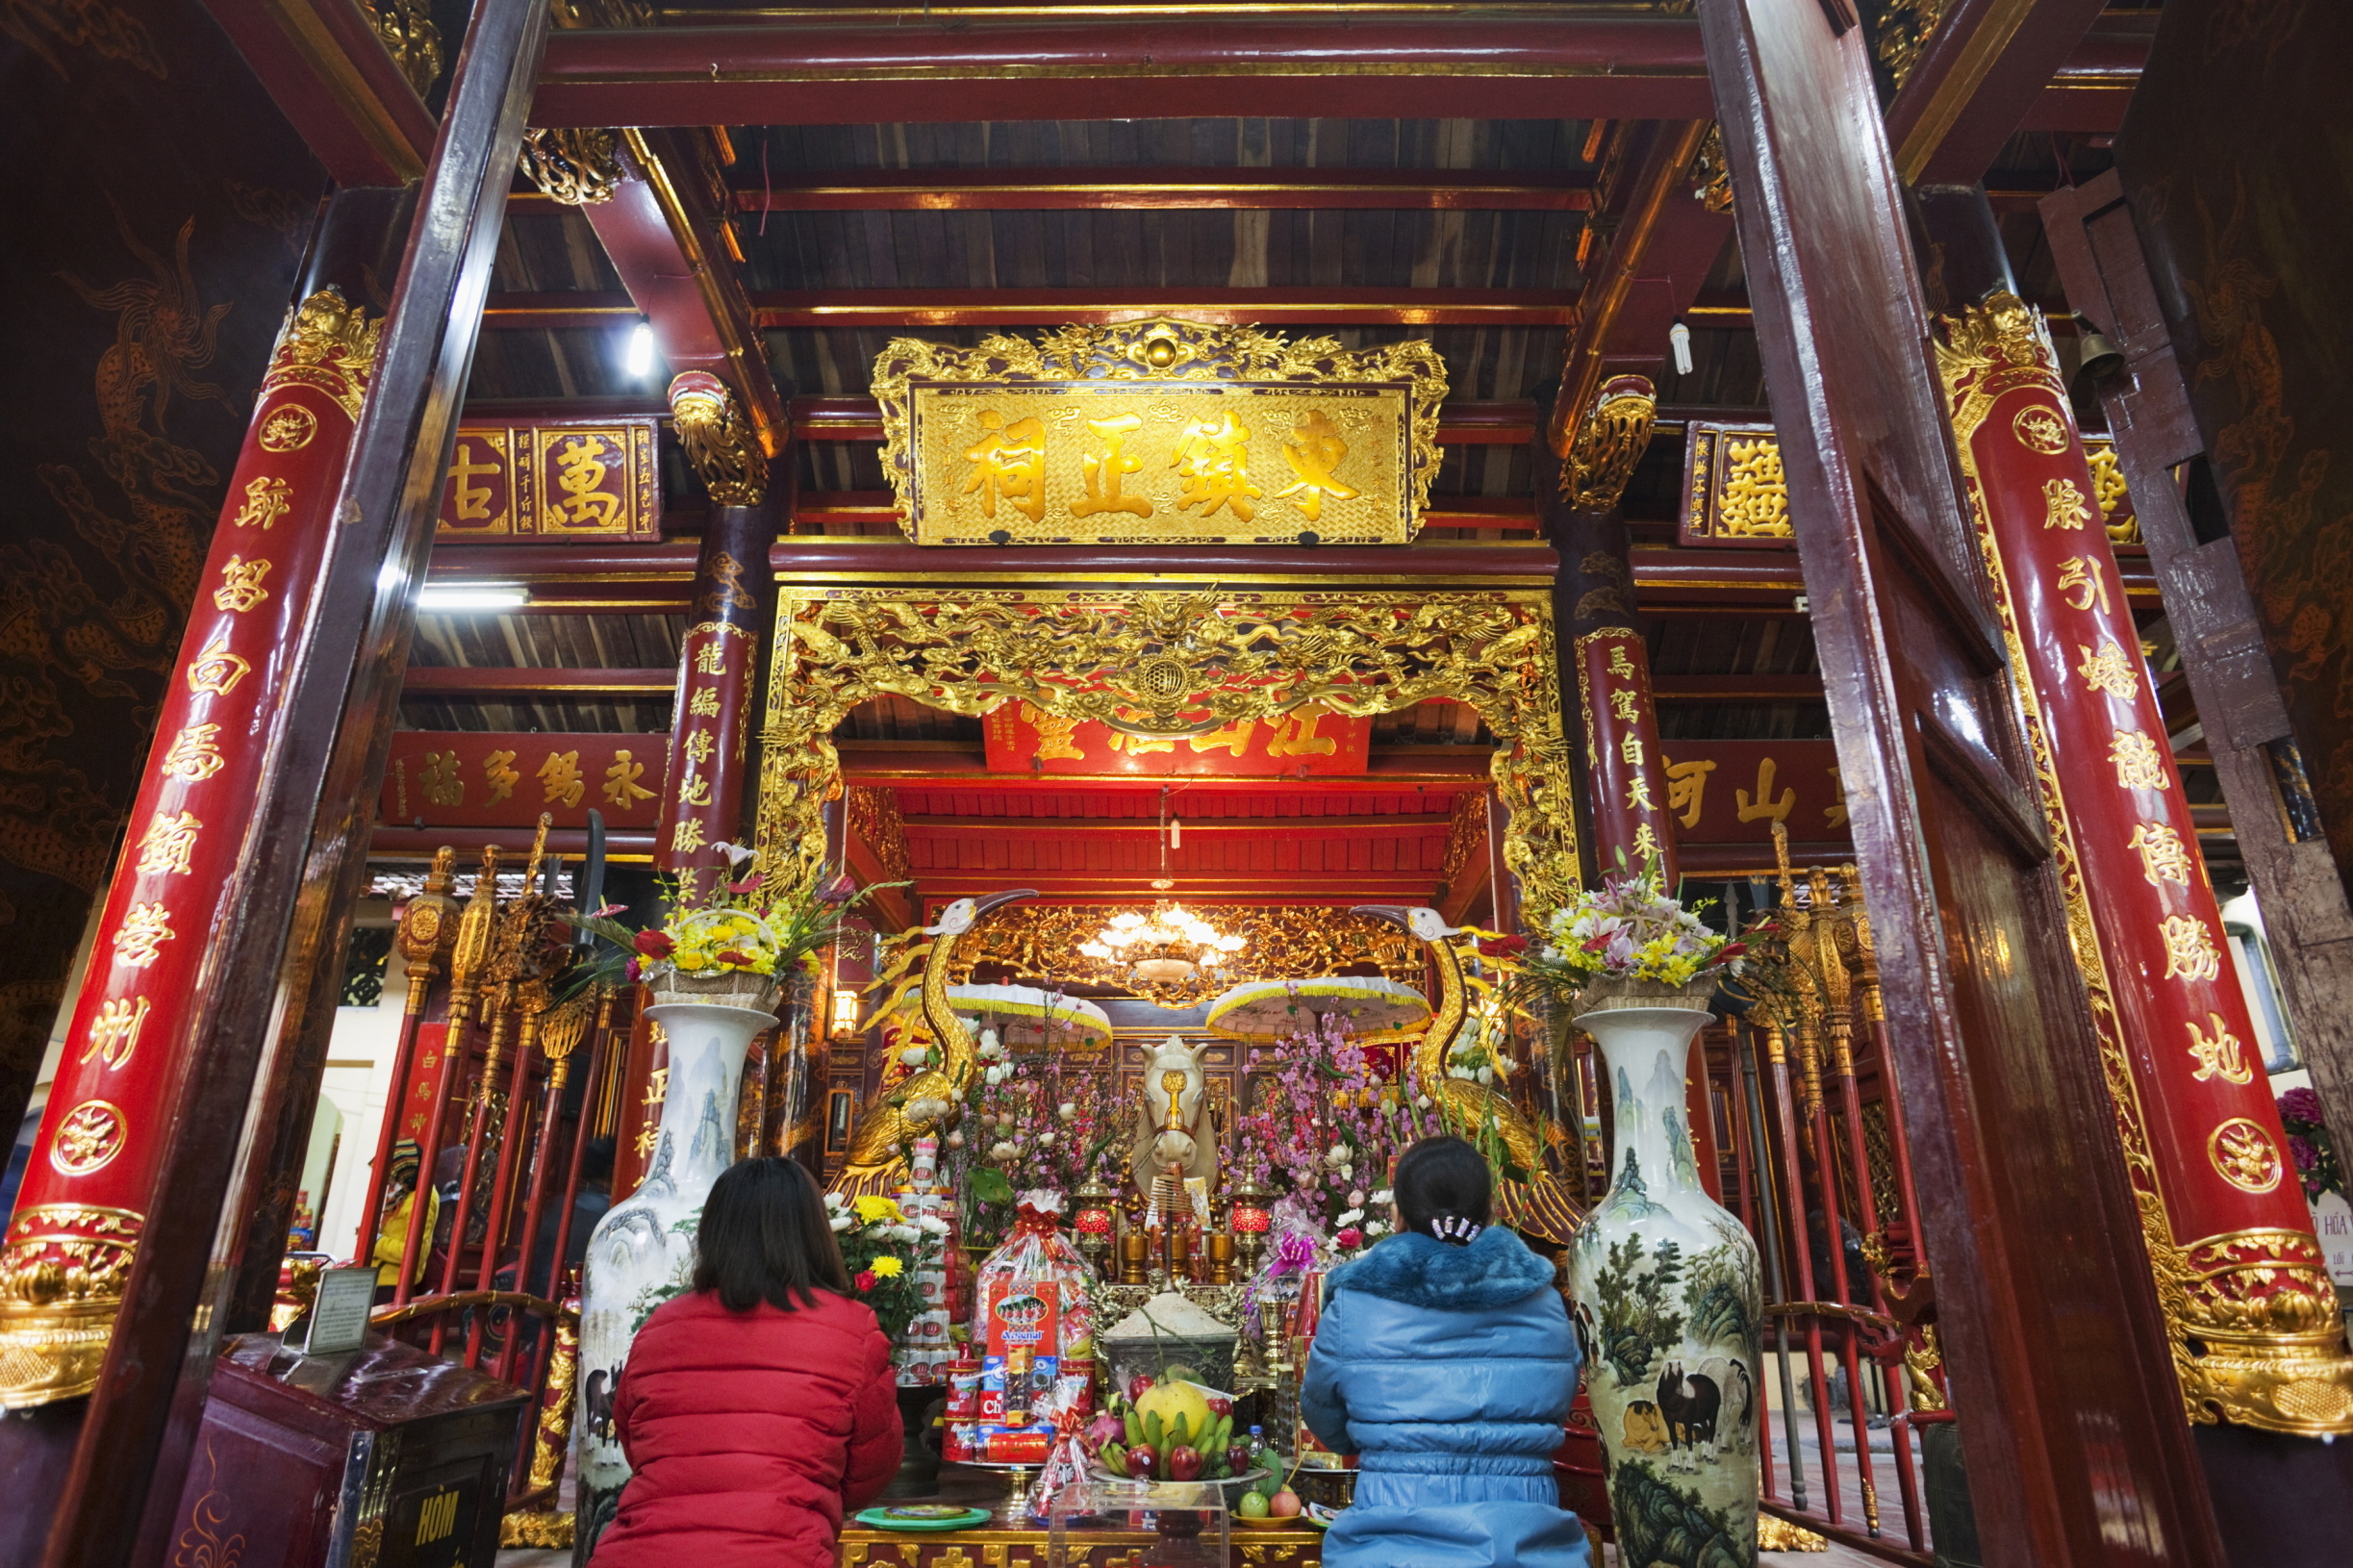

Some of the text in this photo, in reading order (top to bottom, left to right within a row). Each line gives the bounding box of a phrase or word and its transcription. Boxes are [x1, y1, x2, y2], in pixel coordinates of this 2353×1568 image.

[964, 409, 1361, 523] 東鎮正祠
[418, 748, 659, 810] 永錫多福
[2324, 1212, 2348, 1235] HÓA
[1001, 1329, 1043, 1340] Arsenal
